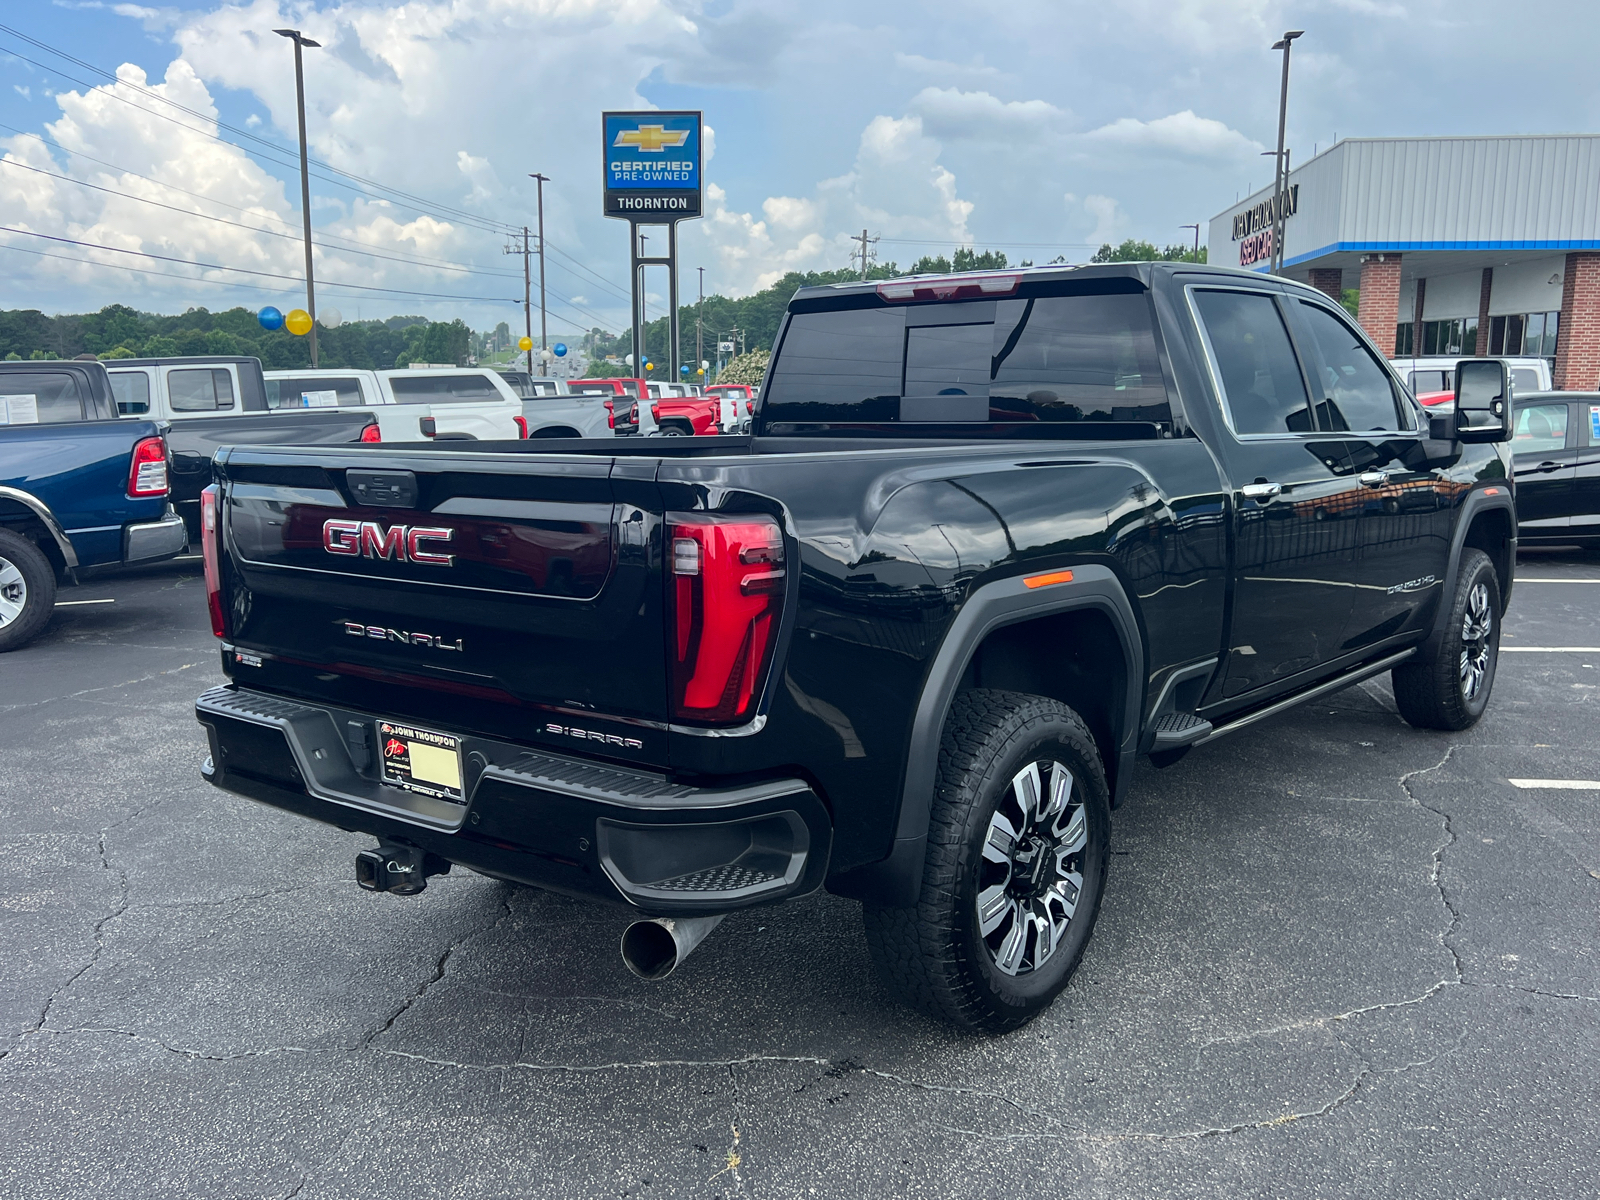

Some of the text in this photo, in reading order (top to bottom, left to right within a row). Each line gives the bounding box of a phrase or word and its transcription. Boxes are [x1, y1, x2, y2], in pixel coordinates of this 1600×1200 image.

[611, 161, 693, 172] CERTIFIED
[615, 171, 689, 181] PRE-OWNED
[617, 198, 687, 209] THORNTON
[1250, 184, 1299, 234] THORNON
[323, 518, 456, 567] GMC
[344, 622, 463, 652] DENALI
[394, 726, 456, 747] JOHN THORNTON
[546, 723, 643, 749] SIERRA
